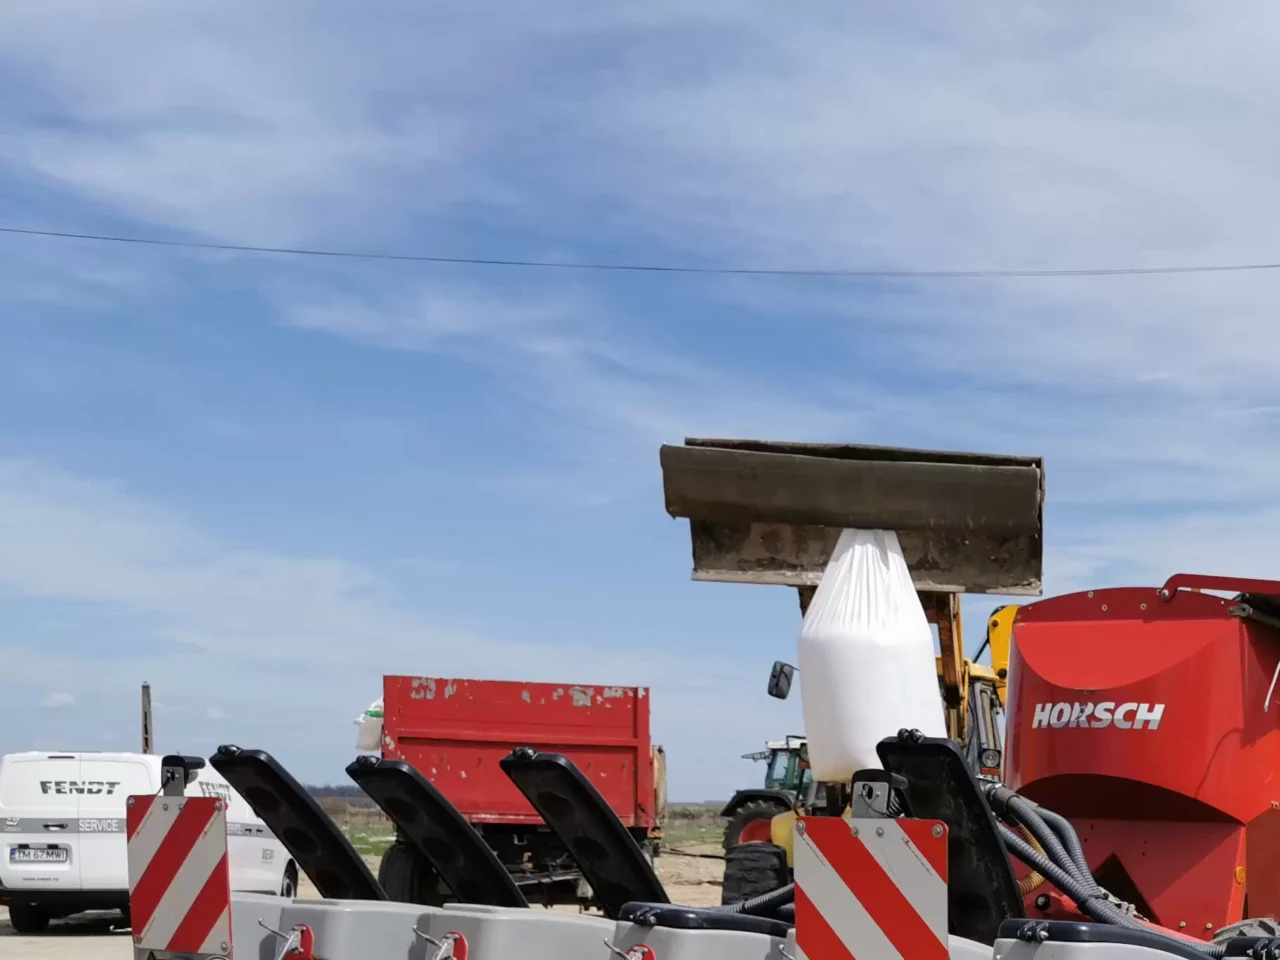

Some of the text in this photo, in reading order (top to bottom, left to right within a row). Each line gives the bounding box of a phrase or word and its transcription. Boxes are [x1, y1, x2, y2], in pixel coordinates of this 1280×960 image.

[1032, 702, 1165, 730] HORSCH
[39, 781, 121, 795] FENDT
[78, 819, 119, 832] SERVICE
[18, 850, 31, 860] TM
[33, 850, 46, 860] 67
